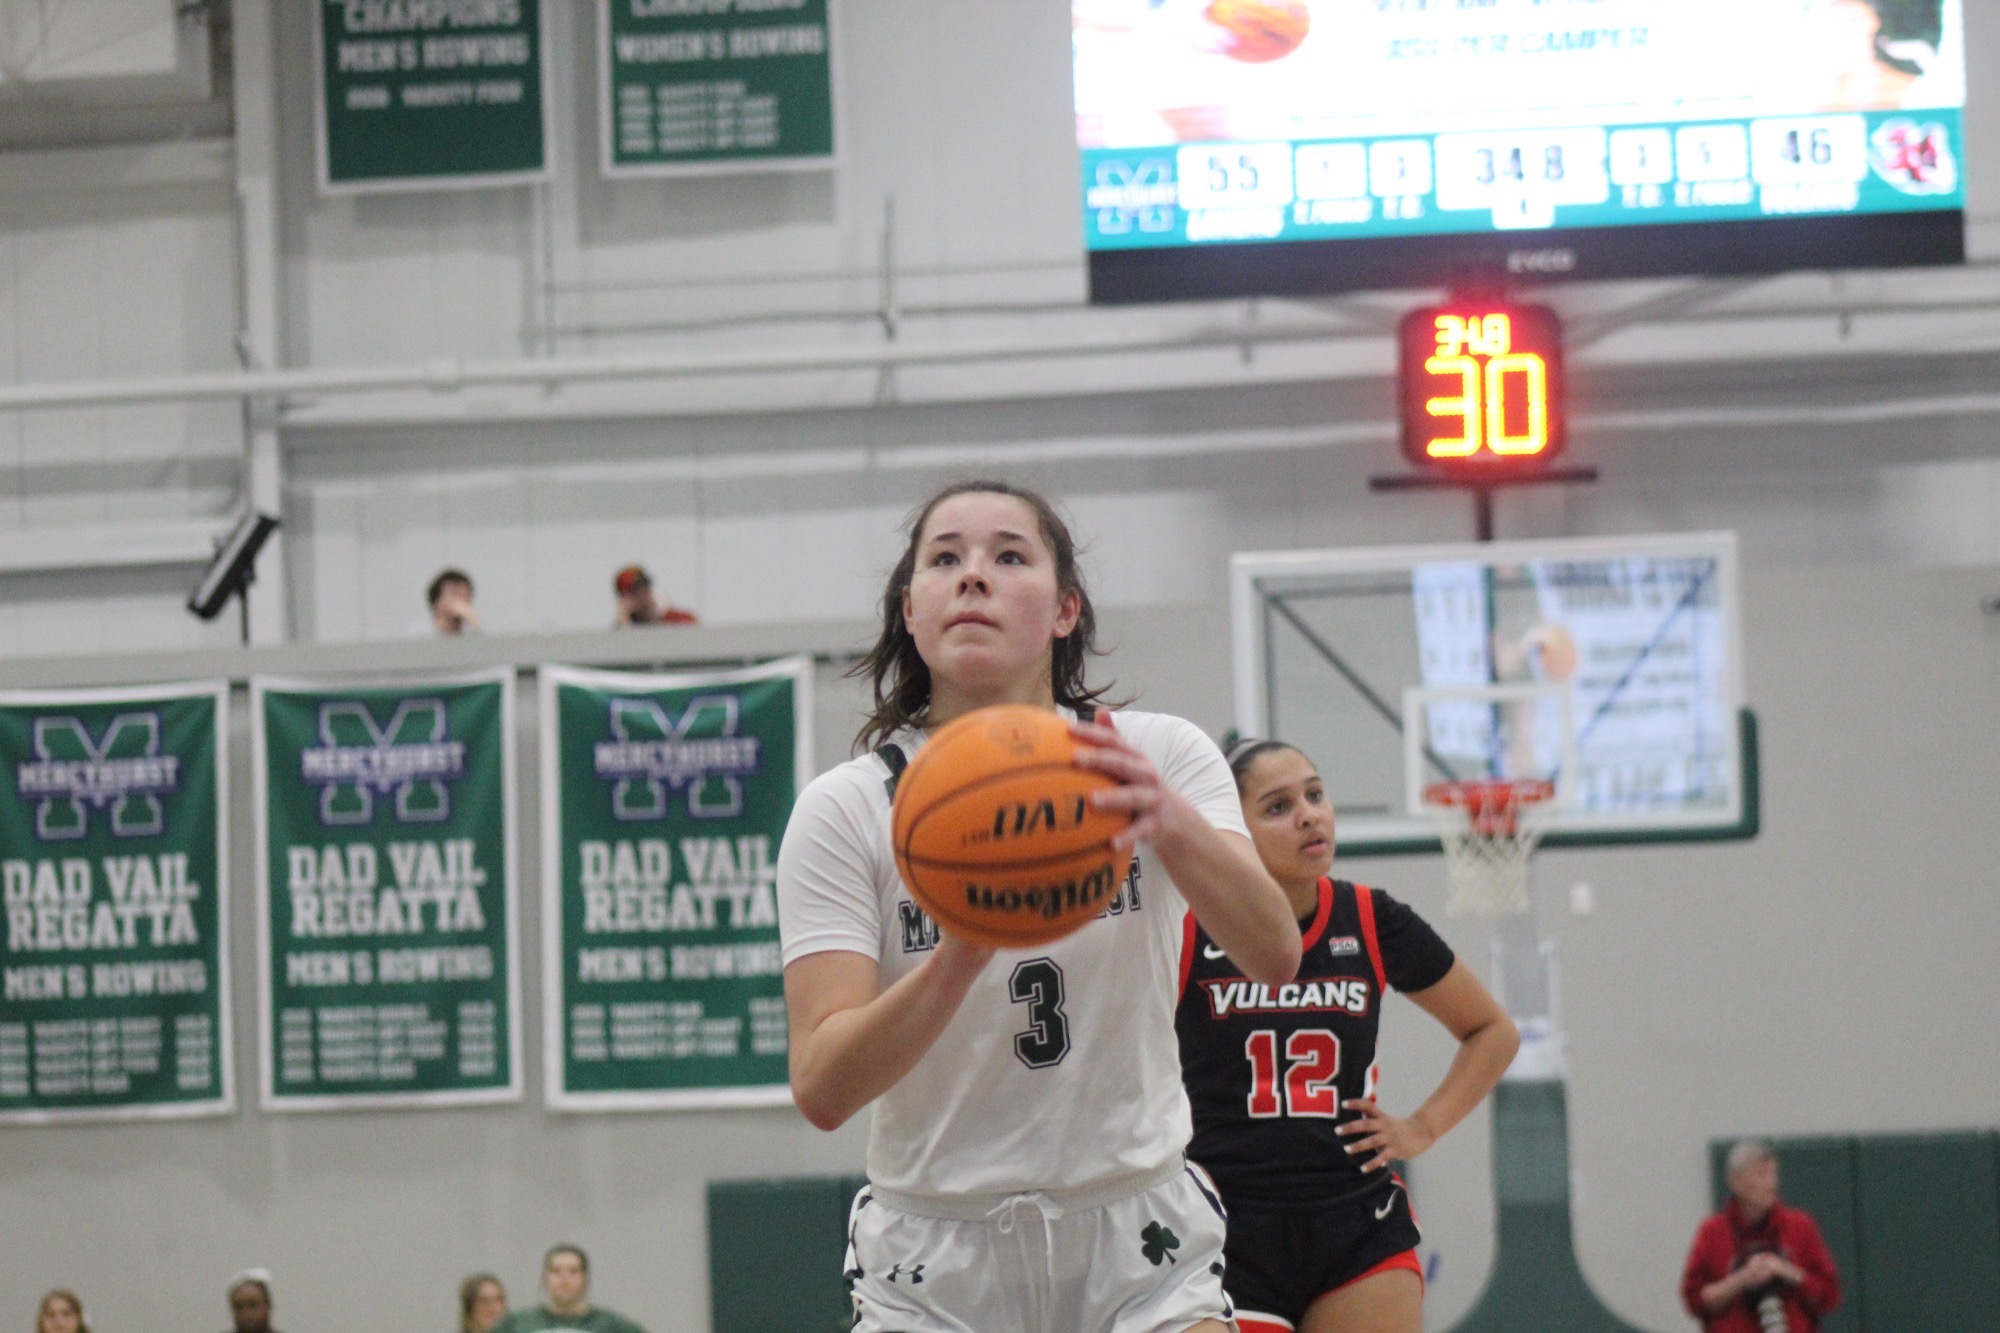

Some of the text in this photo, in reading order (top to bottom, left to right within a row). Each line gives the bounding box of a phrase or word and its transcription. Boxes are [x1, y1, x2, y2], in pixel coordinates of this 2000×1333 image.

[423, 33, 529, 68] ROWING
[729, 25, 822, 57] ROWING
[1783, 129, 1831, 164] 46
[1209, 155, 1258, 192] 55
[1425, 353, 1547, 457] 30
[3, 853, 199, 904] DAD VAIL
[287, 838, 485, 889] DAD VAIL
[580, 834, 777, 885] DAD VAIL
[8, 900, 198, 951] REGATTA
[291, 887, 484, 938] REGATTA
[583, 884, 778, 934] REGATTA
[92, 960, 206, 996] ROWING
[378, 946, 493, 982] ROWING
[1010, 957, 1071, 1069] 3
[1208, 979, 1368, 1016] VULCANS
[1245, 1029, 1340, 1119] 12
